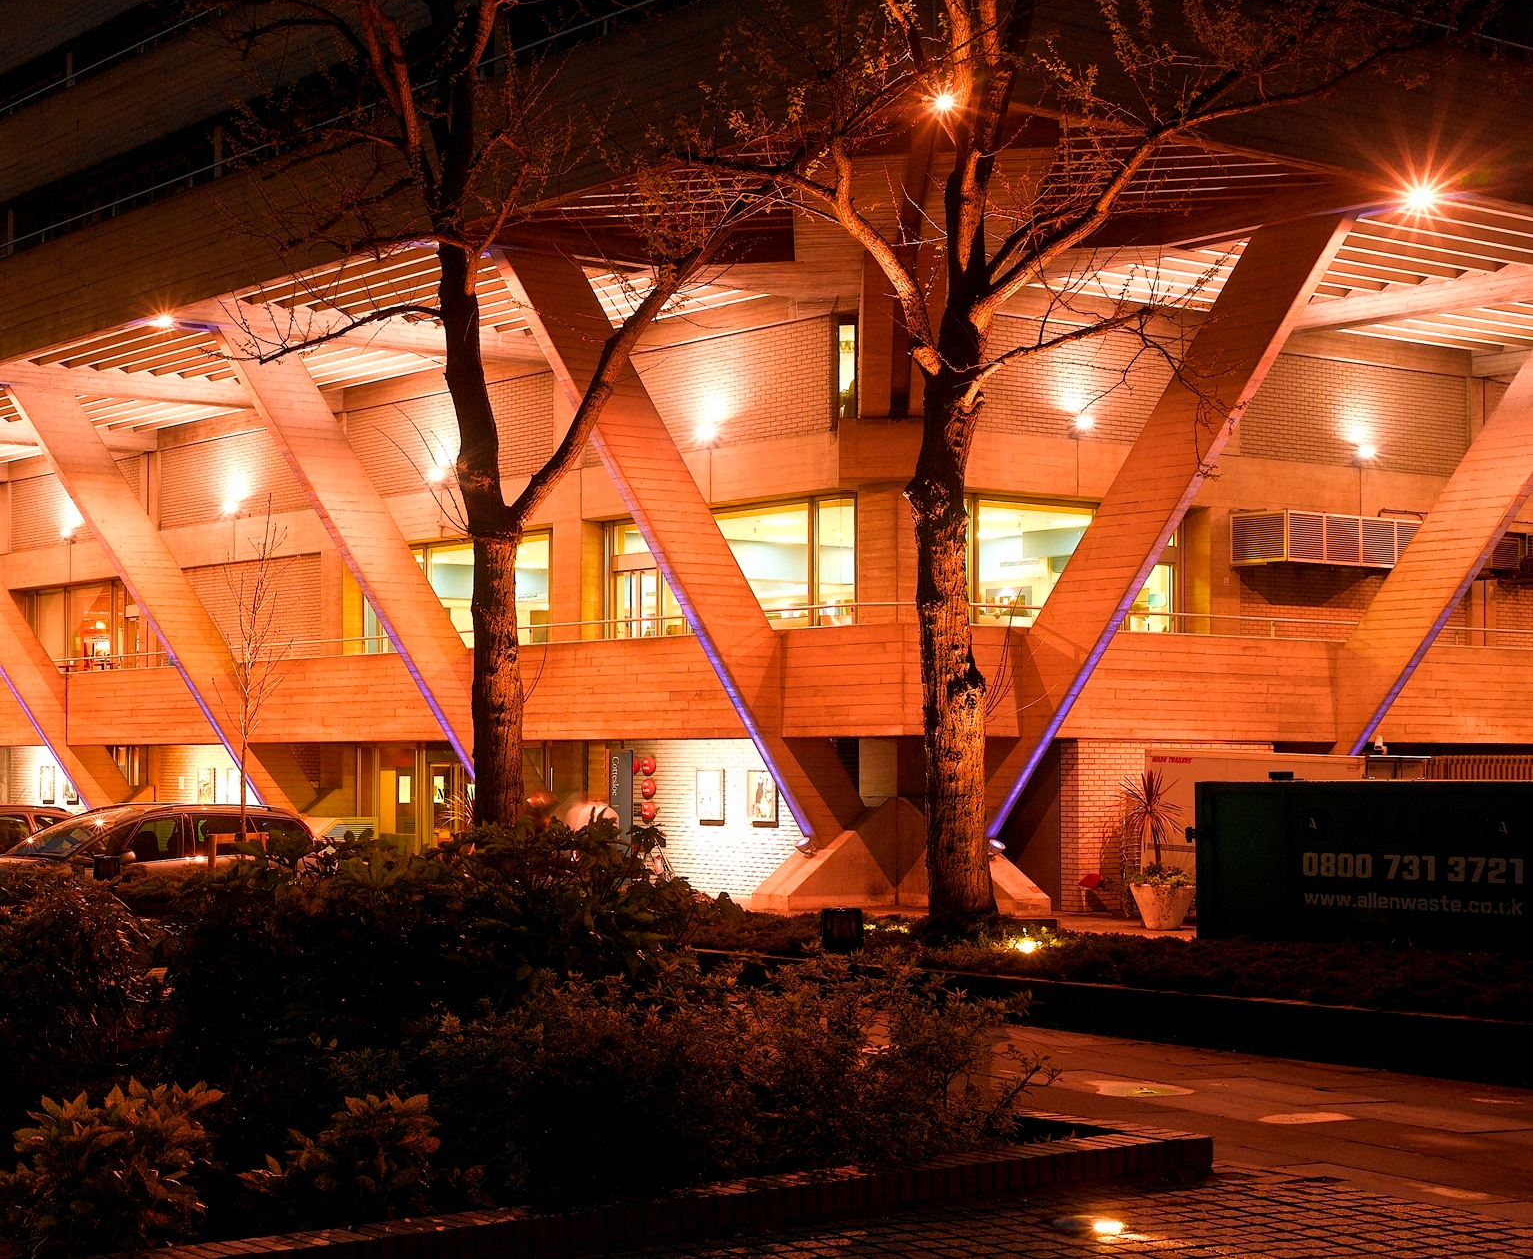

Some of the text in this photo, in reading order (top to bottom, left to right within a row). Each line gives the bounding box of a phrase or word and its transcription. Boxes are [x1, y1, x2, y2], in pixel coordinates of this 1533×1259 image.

[612, 756, 620, 797] Cottesloe
[1303, 852, 1523, 883] 0800 731 3721
[1304, 892, 1524, 916] www.allenwaste.co.uk
